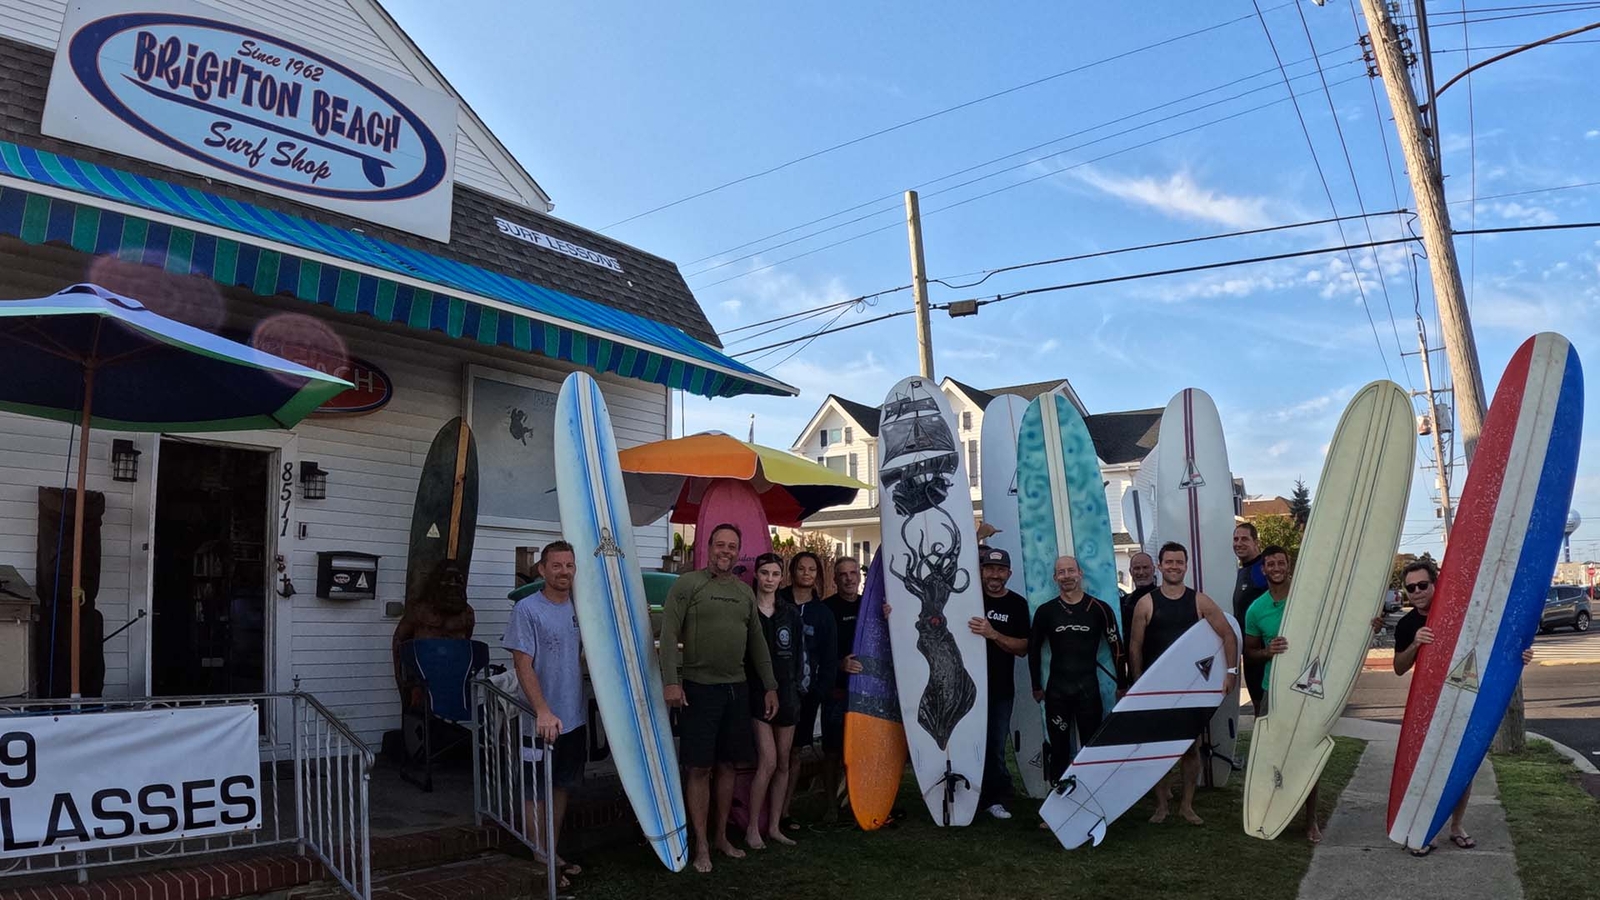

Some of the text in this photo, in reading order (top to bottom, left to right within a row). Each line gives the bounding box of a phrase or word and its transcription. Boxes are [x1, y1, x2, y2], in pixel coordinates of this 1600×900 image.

[238, 39, 326, 82] Since 1962
[311, 88, 402, 153] BEACH
[204, 121, 332, 183] Surf Shop
[496, 219, 620, 270] SURF LESSONS
[988, 610, 1009, 622] Coast
